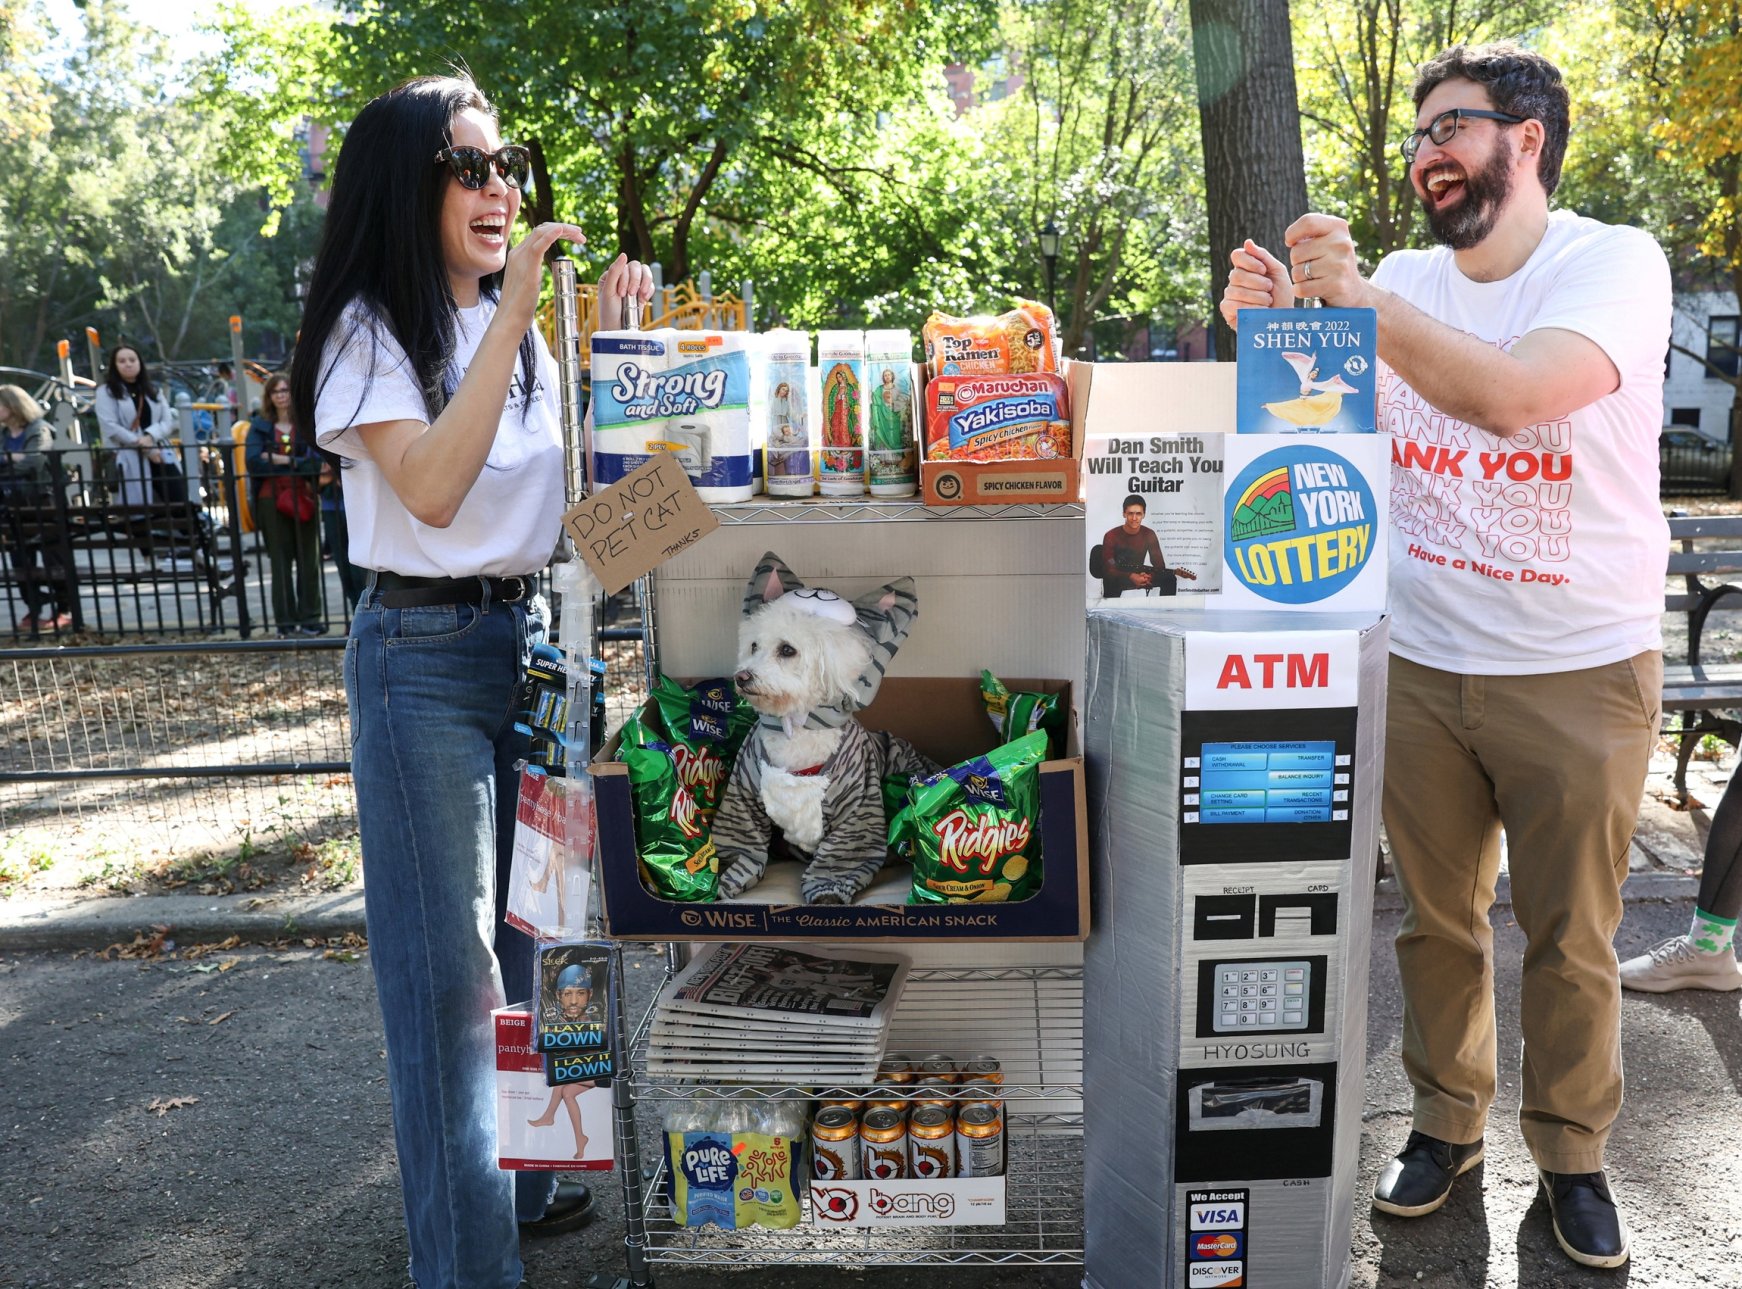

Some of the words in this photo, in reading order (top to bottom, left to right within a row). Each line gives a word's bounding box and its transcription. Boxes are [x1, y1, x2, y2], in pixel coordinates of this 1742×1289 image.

[1266, 321, 1322, 332] 神韻晚會
[1324, 320, 1350, 331] 2022
[619, 343, 637, 351] BATH
[637, 344, 661, 352] TISSUE
[680, 343, 686, 351] 4
[942, 336, 973, 351] Top
[1253, 332, 1311, 349] SHEN
[1317, 331, 1362, 349] YUN
[944, 348, 999, 361] Ramen
[959, 360, 996, 369] CHICKEN
[611, 361, 727, 410] Strong
[971, 380, 1049, 394] Maruchan
[624, 400, 660, 420] and
[659, 393, 699, 417] Soft
[956, 399, 1052, 435] Yakisoba
[1108, 438, 1144, 455] Dan
[1150, 437, 1204, 454] Smith
[1478, 422, 1572, 454] YOU
[1087, 457, 1123, 474] Will
[1128, 457, 1183, 474] Teach
[1189, 456, 1224, 474] You
[1392, 437, 1469, 478] ANK
[1479, 451, 1573, 482] YOU
[1293, 462, 1349, 490] NEW
[983, 482, 1004, 491] SPICY
[1004, 481, 1035, 491] CHICKEN
[1035, 480, 1063, 490] FLAVOR
[1128, 476, 1184, 494] Guitar
[571, 502, 613, 540] DO
[619, 465, 665, 511] NOT
[1472, 482, 1573, 511] YOU
[1298, 490, 1365, 528] YORK
[589, 518, 638, 566] PET
[643, 489, 682, 531] CAT
[1470, 507, 1572, 536] YOU
[661, 528, 700, 557] THANKS
[1476, 534, 1571, 563] YOU
[1234, 523, 1371, 586] LOTTERY
[1407, 543, 1447, 566] Have
[1452, 557, 1467, 571] a
[1471, 560, 1515, 582] Nice
[1520, 568, 1571, 587] Day.
[535, 658, 558, 671] SUPER
[1216, 653, 1329, 689] ATM
[692, 718, 724, 737] WISE
[964, 783, 1000, 801] WISE
[935, 810, 1030, 872] Ridgies
[946, 884, 964, 892] CREAM
[1223, 886, 1255, 895] RECEIPT
[1307, 884, 1329, 893] CARD
[704, 911, 757, 928] WISE
[771, 915, 792, 924] THE
[795, 912, 852, 928] Classic
[855, 914, 941, 927] AMERICAN
[944, 914, 998, 927] SNACK
[1224, 973, 1230, 982] 1
[1243, 973, 1249, 981] 2
[1262, 972, 1268, 980] 3
[1223, 987, 1229, 995] 4
[1243, 987, 1249, 995] 5
[1262, 986, 1268, 994] 6
[1223, 1002, 1229, 1010] 7
[1242, 1001, 1248, 1009] 8
[1261, 1000, 1267, 1008] 9
[499, 1018, 527, 1027] BEIGE
[1241, 1015, 1247, 1023] 0
[553, 1023, 586, 1033] LAY
[589, 1023, 601, 1031] IT
[543, 1030, 603, 1047] DOWN
[498, 1043, 533, 1056] pantyh
[1203, 1041, 1312, 1061] HYOSUNG
[553, 1060, 559, 1068] I
[563, 1055, 595, 1067] LAY
[598, 1052, 612, 1061] IT
[554, 1060, 613, 1081] DOWN
[1282, 1179, 1311, 1188] CASH
[869, 1187, 956, 1219] bang
[1191, 1193, 1208, 1202] We
[1209, 1192, 1245, 1201] Accept
[1195, 1209, 1239, 1224] VISA
[1196, 1242, 1237, 1250] MasterCard
